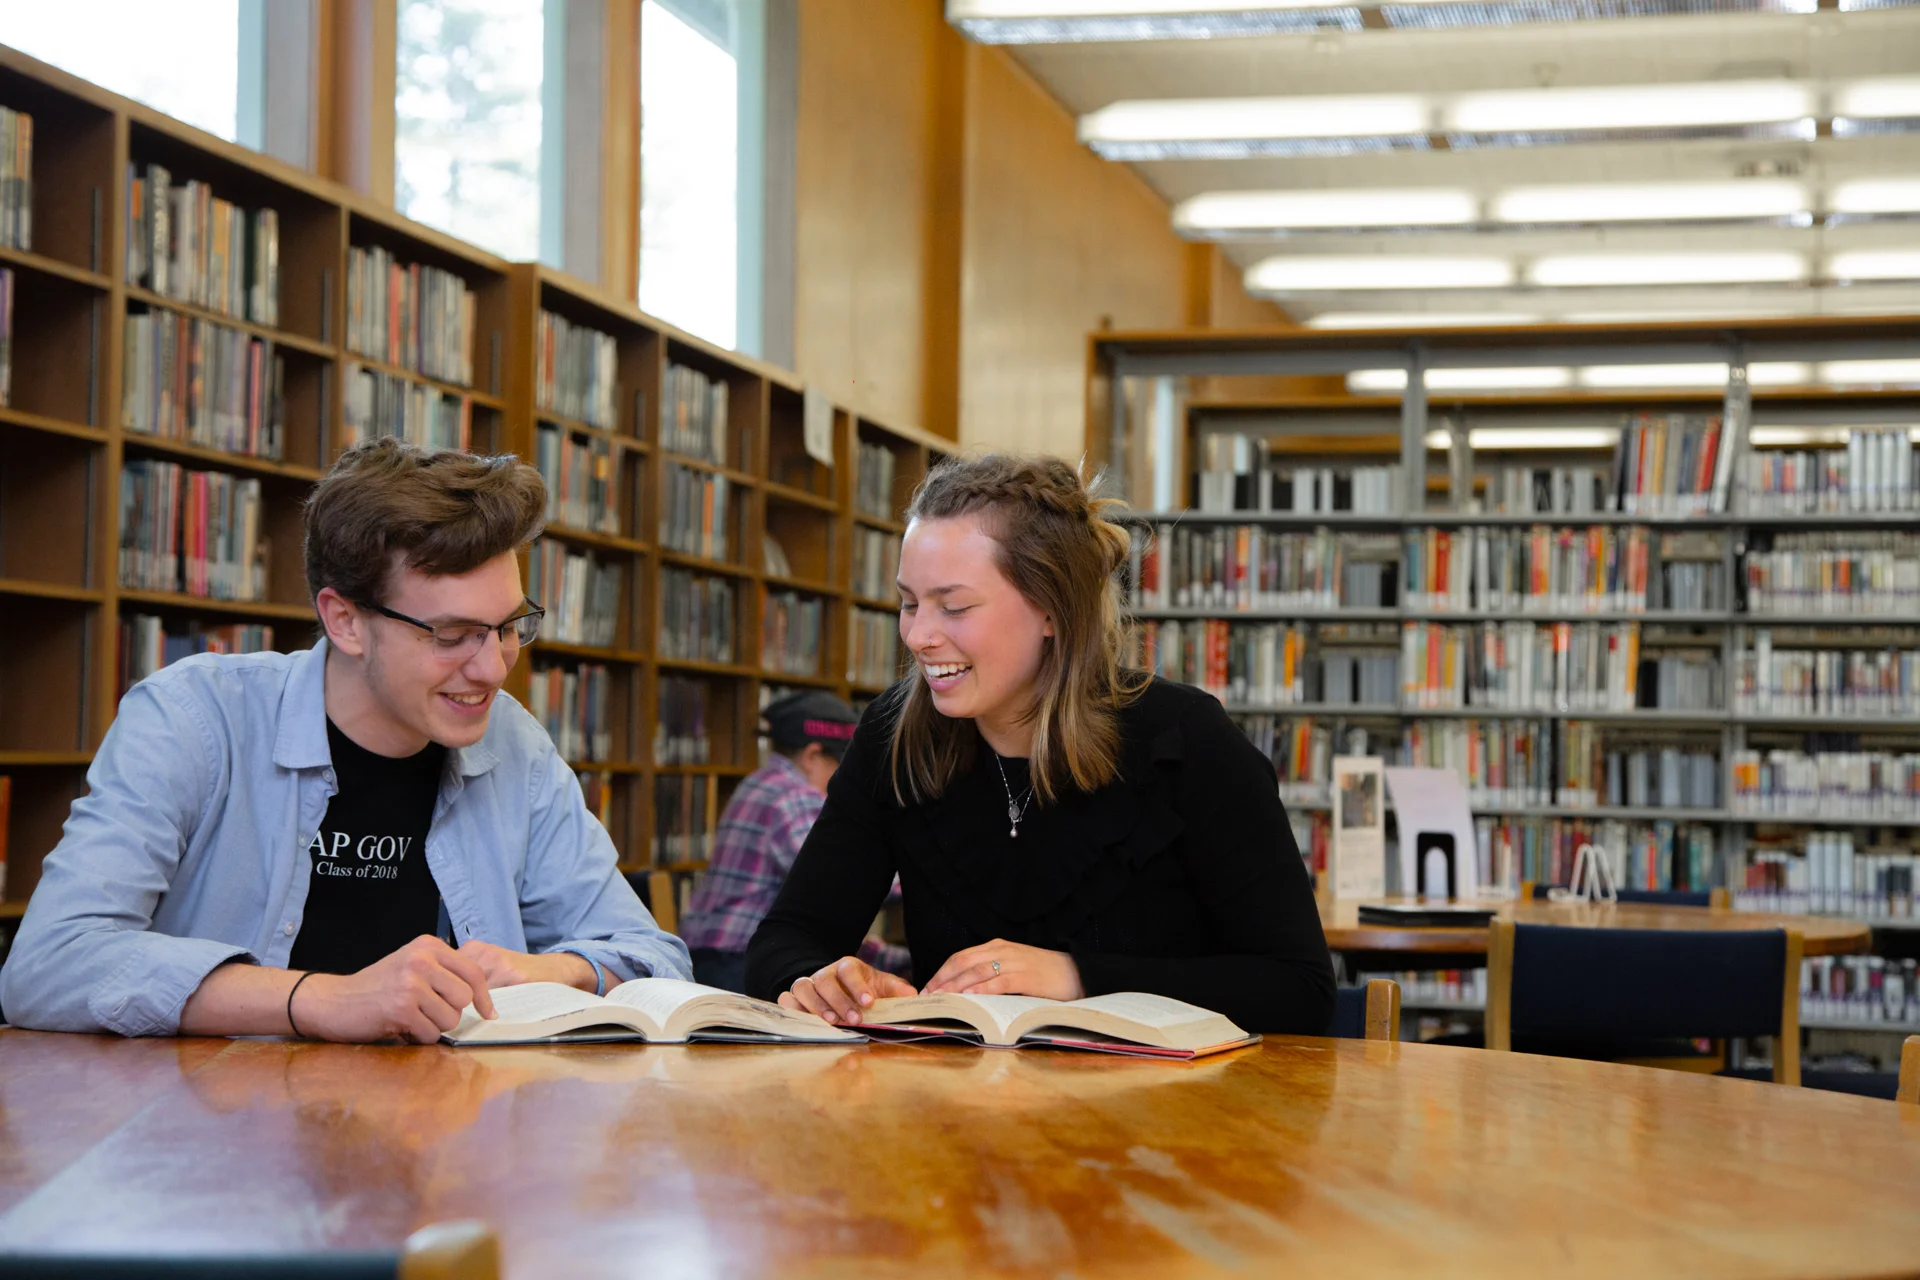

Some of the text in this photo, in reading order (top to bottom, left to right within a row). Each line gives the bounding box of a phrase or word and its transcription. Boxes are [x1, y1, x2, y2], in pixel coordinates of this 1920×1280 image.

[308, 830, 412, 861] AP GOV
[316, 861, 398, 879] Class of 2018
